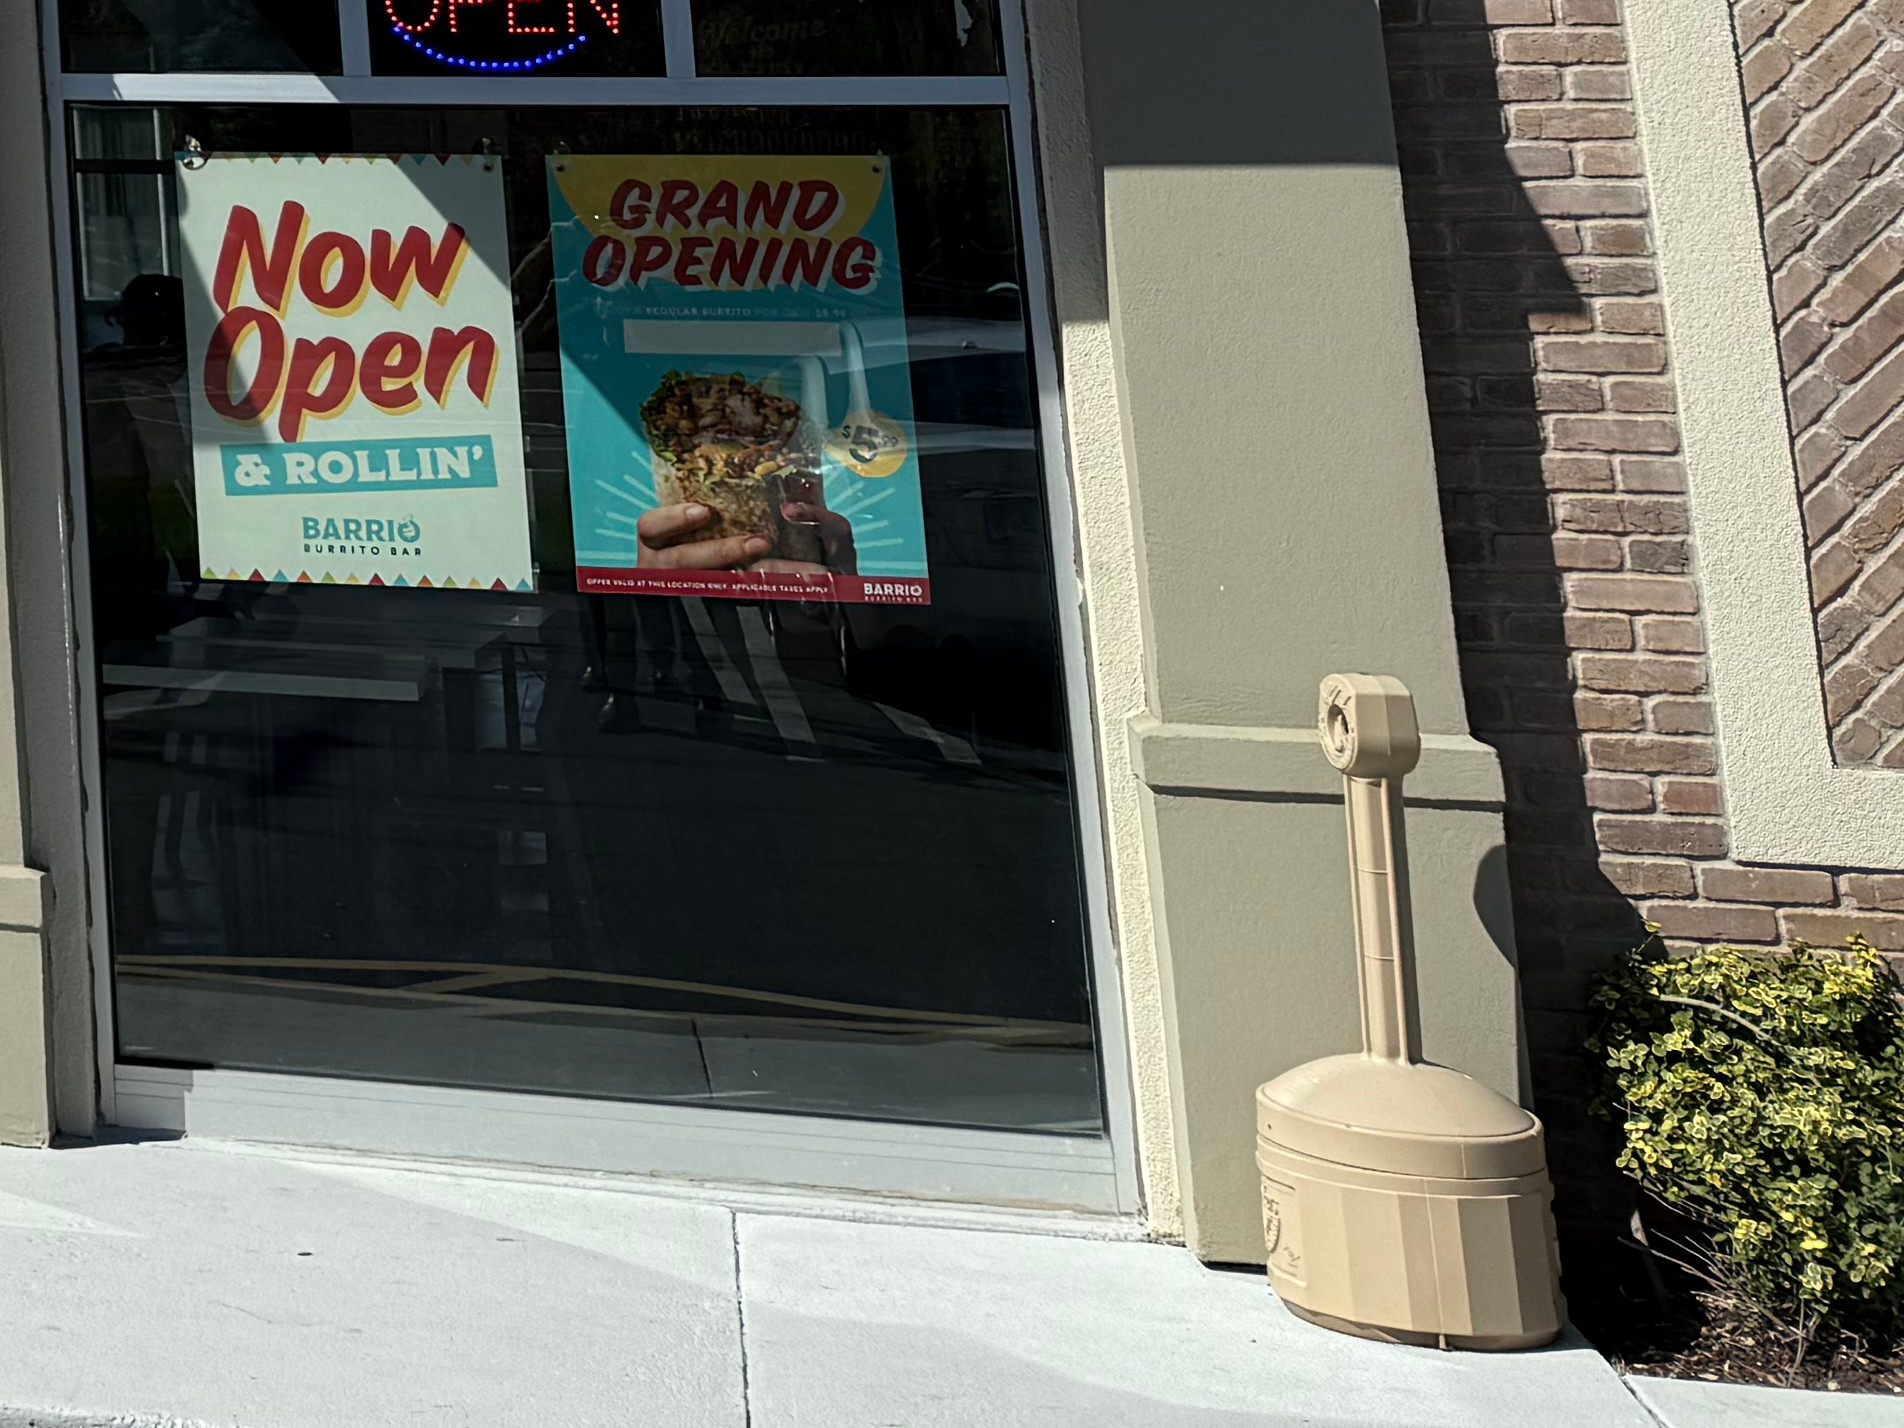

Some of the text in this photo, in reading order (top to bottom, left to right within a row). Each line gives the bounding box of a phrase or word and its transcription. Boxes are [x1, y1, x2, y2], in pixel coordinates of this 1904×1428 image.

[609, 178, 844, 233] GRAND
[212, 199, 469, 318] Now
[581, 234, 879, 291] OPENING
[203, 305, 498, 443] Open
[234, 445, 483, 487] & ROLLIN'
[302, 514, 421, 543] BARRIO
[304, 543, 422, 556] BURRITO BAR
[586, 577, 611, 586] OFFER
[612, 578, 635, 587] VALID
[637, 579, 646, 587] AT
[667, 581, 706, 590] LOCATION
[863, 582, 923, 597] BARRIO
